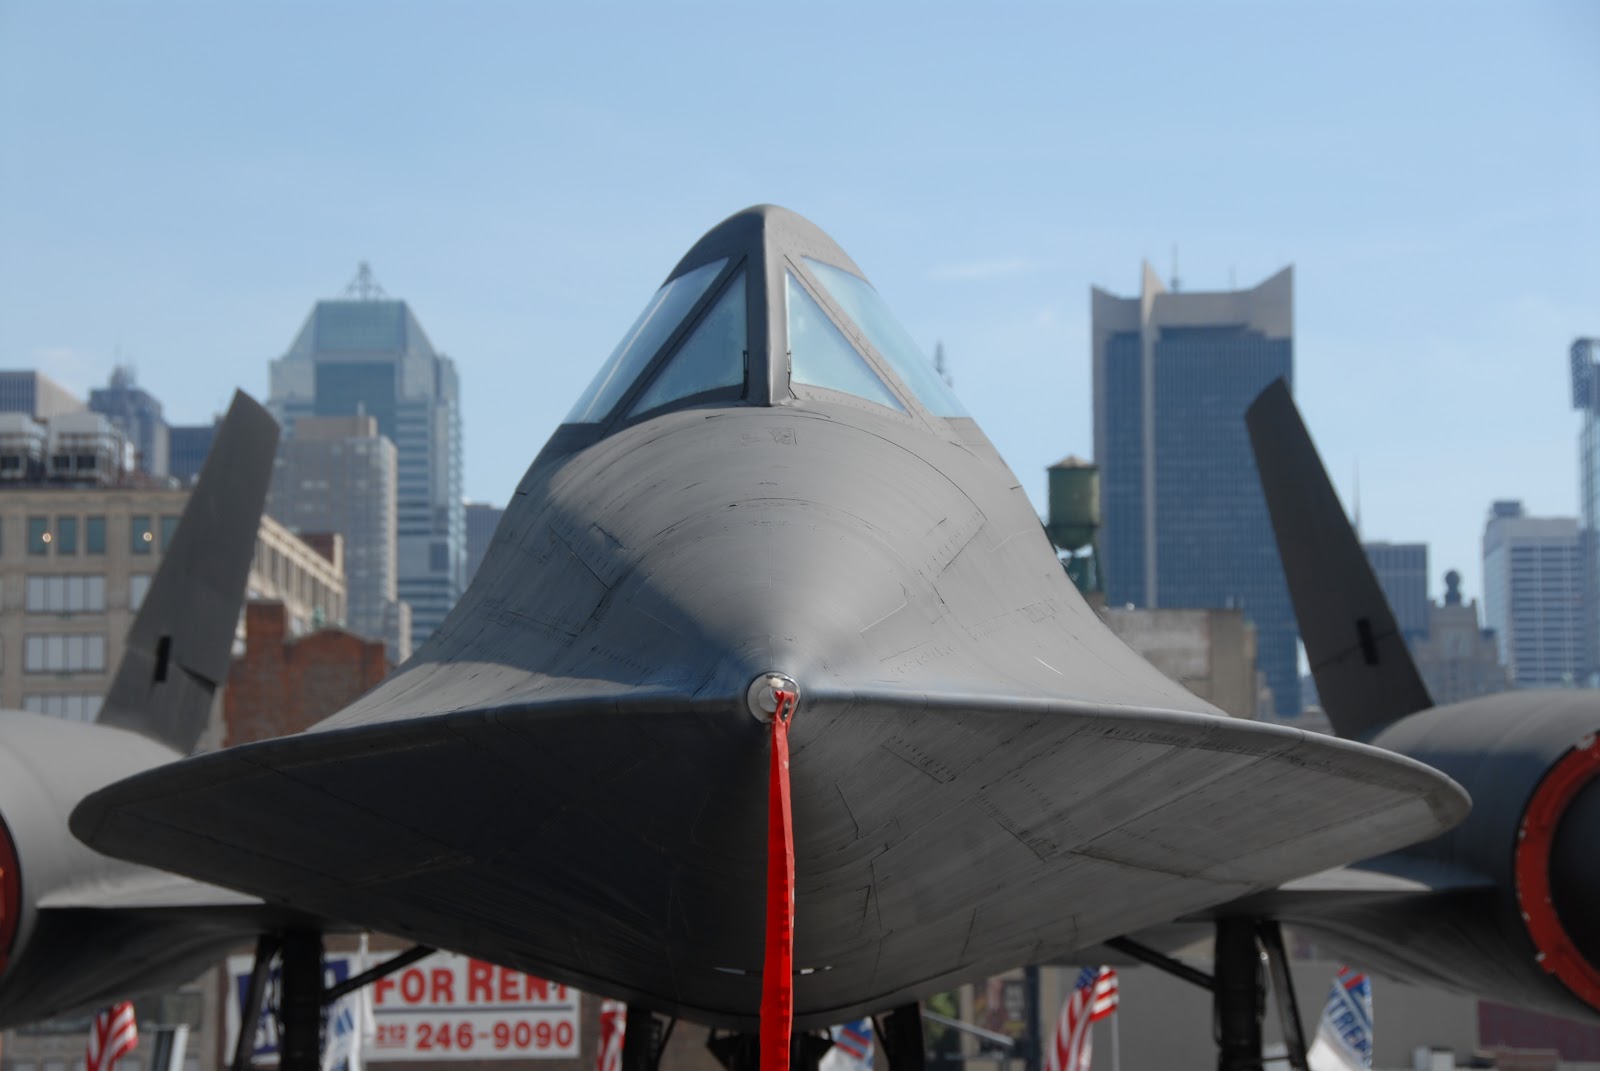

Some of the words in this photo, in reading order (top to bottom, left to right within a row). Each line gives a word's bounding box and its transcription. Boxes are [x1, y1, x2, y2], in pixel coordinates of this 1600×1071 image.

[375, 967, 453, 1003] FOR
[376, 1025, 407, 1043] 212
[416, 1021, 573, 1050] 246-9090
